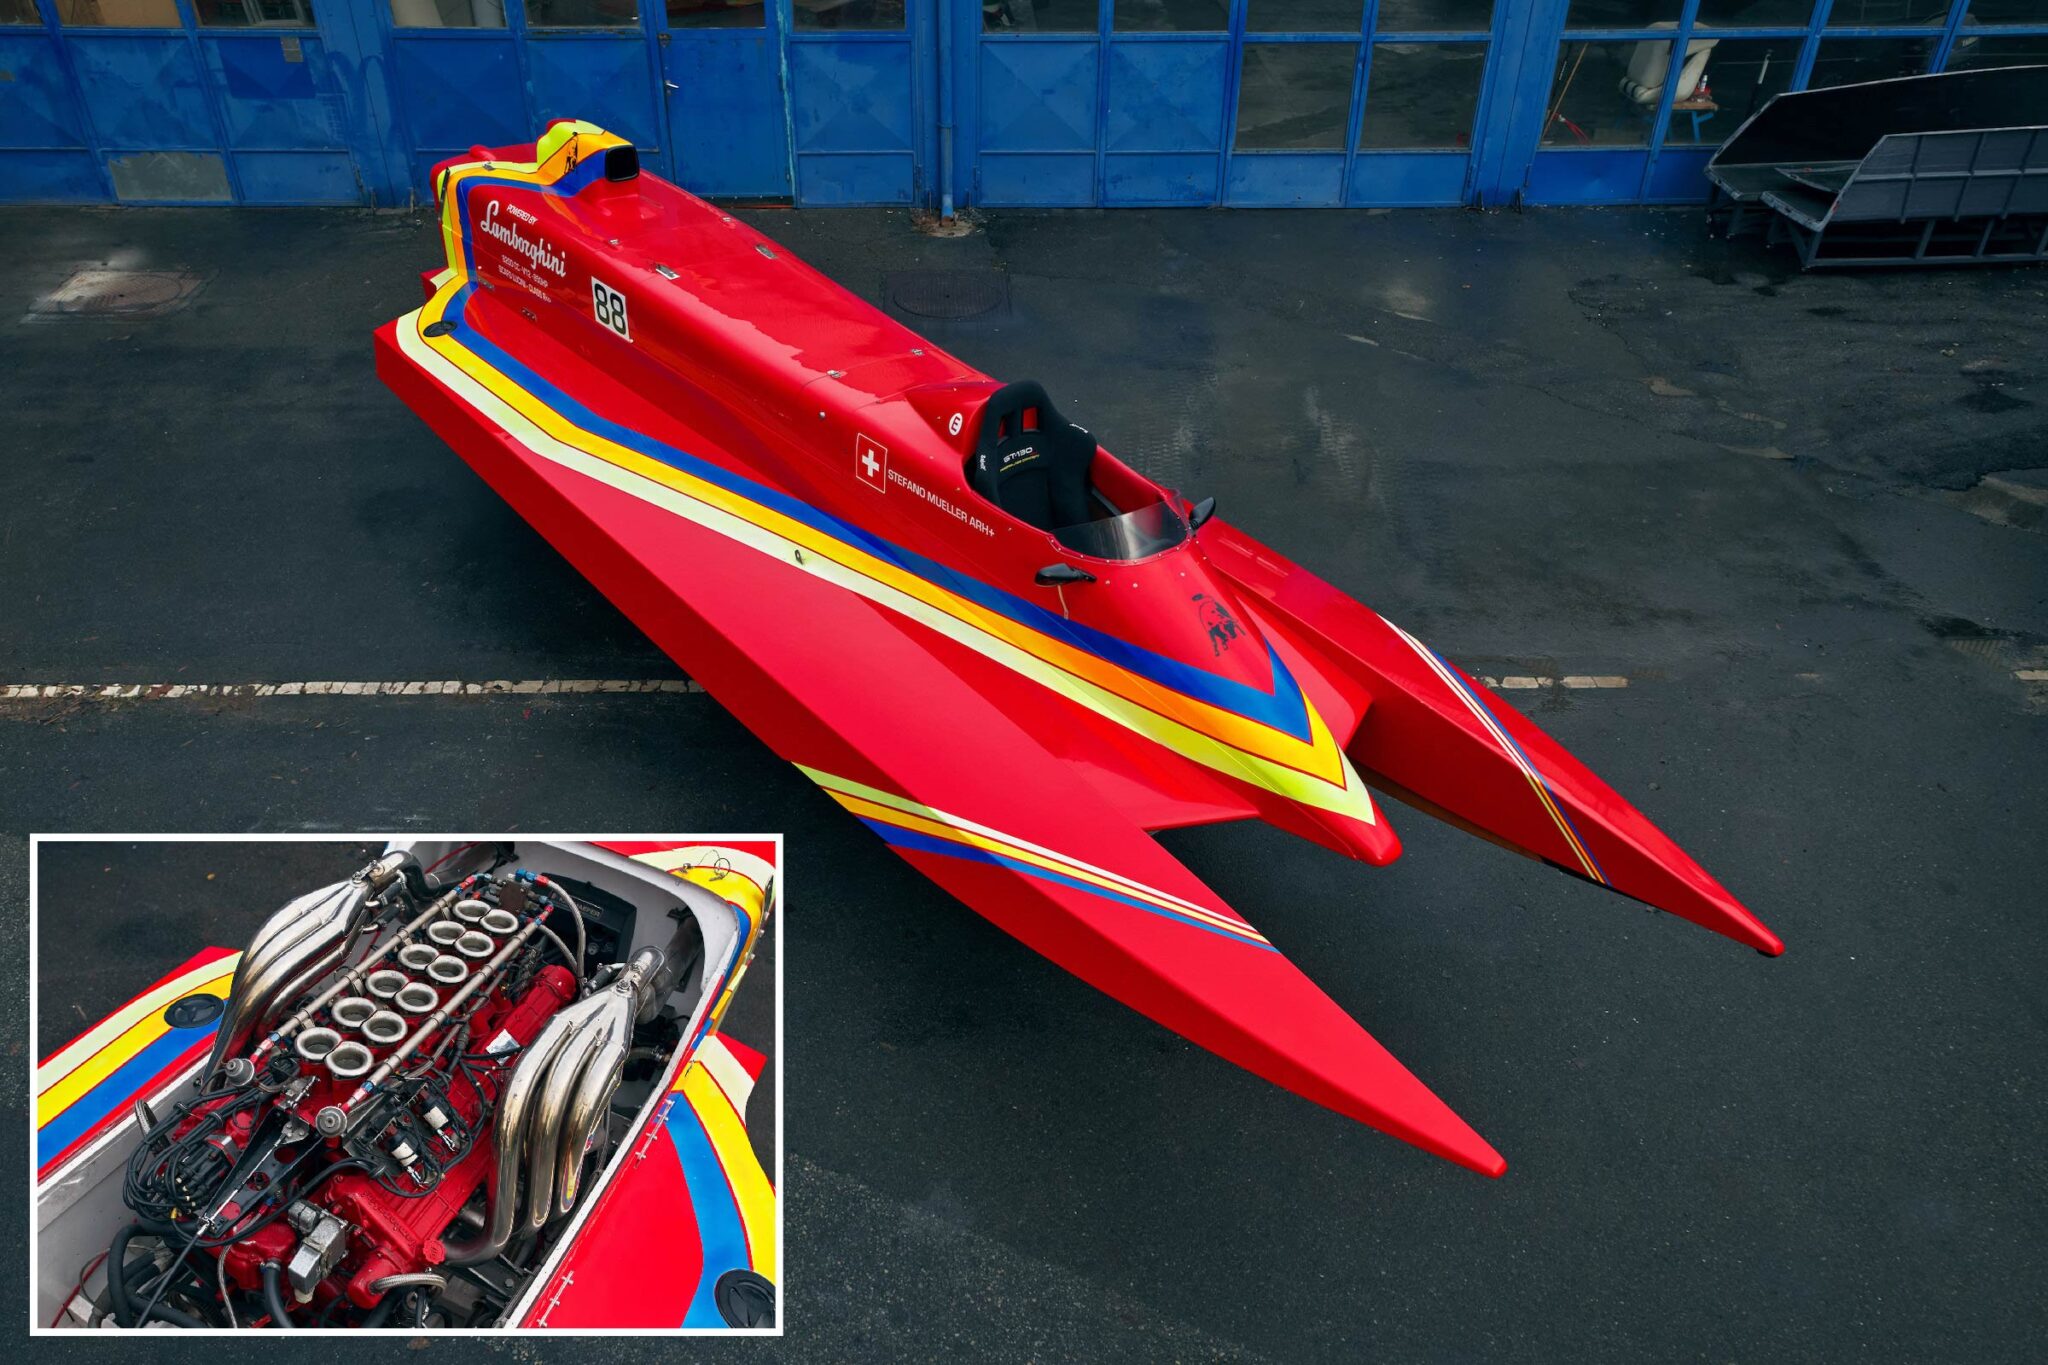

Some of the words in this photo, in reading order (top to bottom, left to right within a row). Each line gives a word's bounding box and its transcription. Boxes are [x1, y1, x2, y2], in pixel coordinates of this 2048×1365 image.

[480, 200, 566, 278] Lamborghini
[506, 203, 531, 222] POWERED
[528, 215, 539, 226] BY
[594, 283, 627, 335] 88
[888, 469, 926, 498] STEFANO
[927, 491, 968, 523] MUELLER
[969, 516, 995, 537] ARH+
